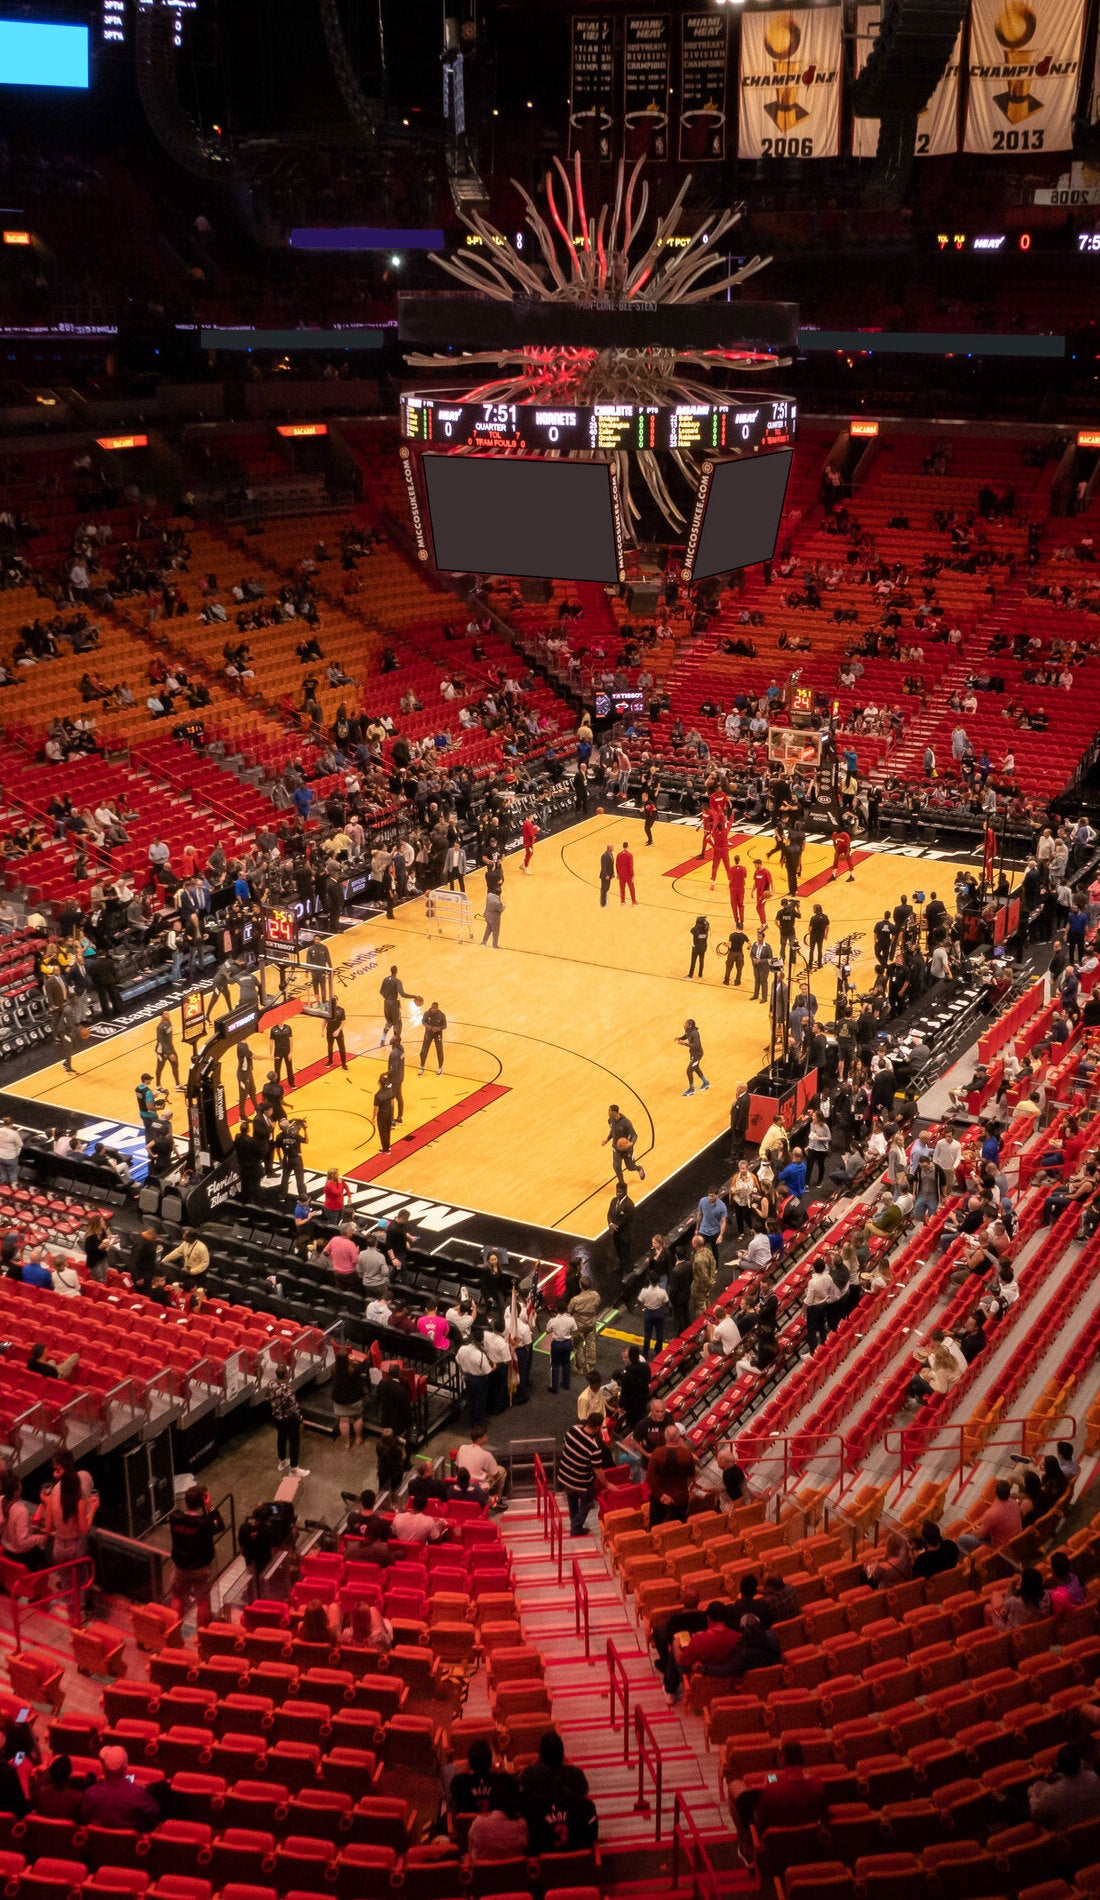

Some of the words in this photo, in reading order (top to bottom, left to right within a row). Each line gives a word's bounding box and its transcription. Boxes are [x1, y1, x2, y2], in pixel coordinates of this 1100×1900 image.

[174, 35, 182, 46] 0
[761, 138, 813, 157] 2006
[992, 130, 1045, 151] 2013
[974, 236, 1005, 249] HEAT
[1020, 235, 1030, 249] 0
[482, 403, 517, 422] 7:51
[535, 412, 577, 426] HORNETS
[772, 402, 788, 420] 7:51
[445, 422, 452, 437] 0
[475, 422, 507, 432] QUARTER
[549, 427, 559, 442] 0
[742, 424, 749, 439] 0
[476, 438, 492, 447] TEAM
[493, 438, 517, 448] FOULS
[520, 440, 526, 448] 0
[402, 459, 425, 548] MICCOSUKEE.COM
[612, 475, 624, 569] MICCOSUKEE.COM
[684, 475, 710, 568] MICCOSUKEE.COM
[794, 696, 810, 709] 24
[272, 909, 293, 923] 7:51
[269, 920, 291, 941] 24
[111, 998, 174, 1027] Baptist
[206, 1170, 240, 1198] Florida
[209, 1190, 230, 1209] Blue
[553, 1823, 569, 1847] 3
